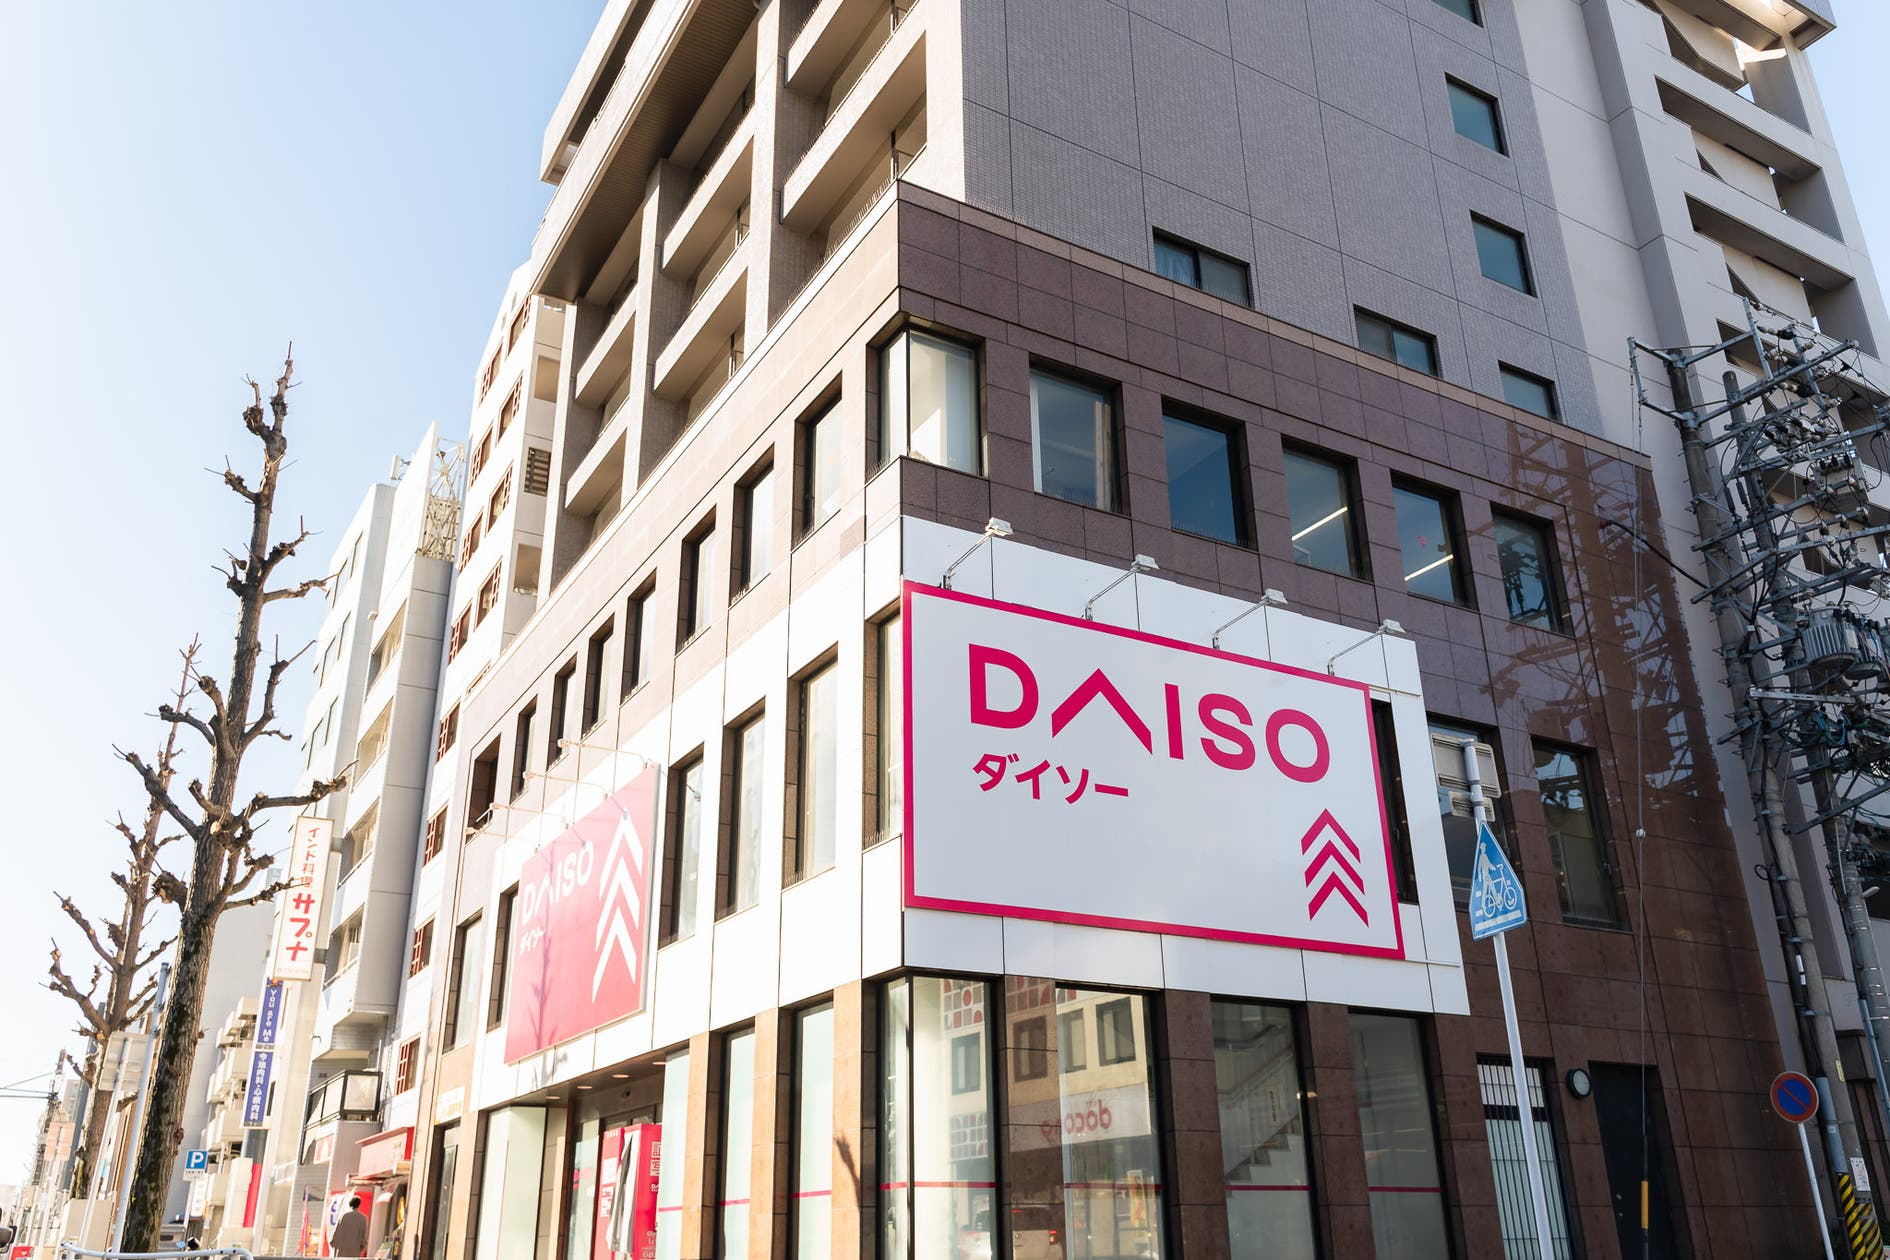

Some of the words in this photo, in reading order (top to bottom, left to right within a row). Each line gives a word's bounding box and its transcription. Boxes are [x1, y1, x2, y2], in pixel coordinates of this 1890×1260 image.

[969, 643, 1330, 783] DAISO
[973, 753, 1129, 804] ダイソー
[522, 840, 594, 925] DAISO
[286, 892, 315, 961] サプナ
[190, 1152, 204, 1168] P
